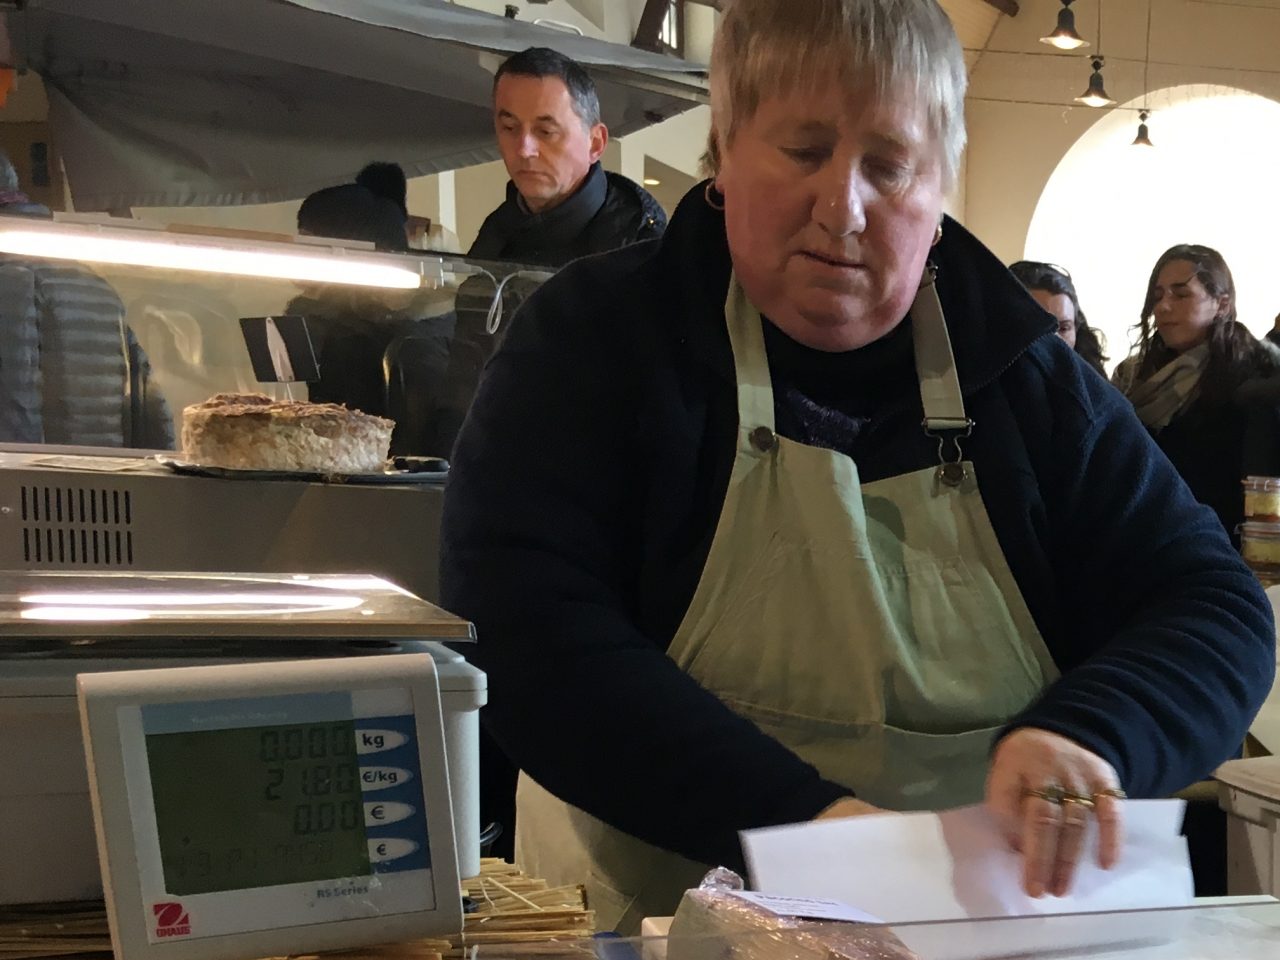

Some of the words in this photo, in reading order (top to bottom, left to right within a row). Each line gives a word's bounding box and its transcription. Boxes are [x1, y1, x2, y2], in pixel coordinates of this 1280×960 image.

[362, 733, 385, 749] kg
[362, 769, 398, 784] €/kg
[370, 805, 386, 820] €
[376, 843, 387, 856] €
[334, 884, 369, 897] Series
[155, 926, 191, 939] OHAUS
